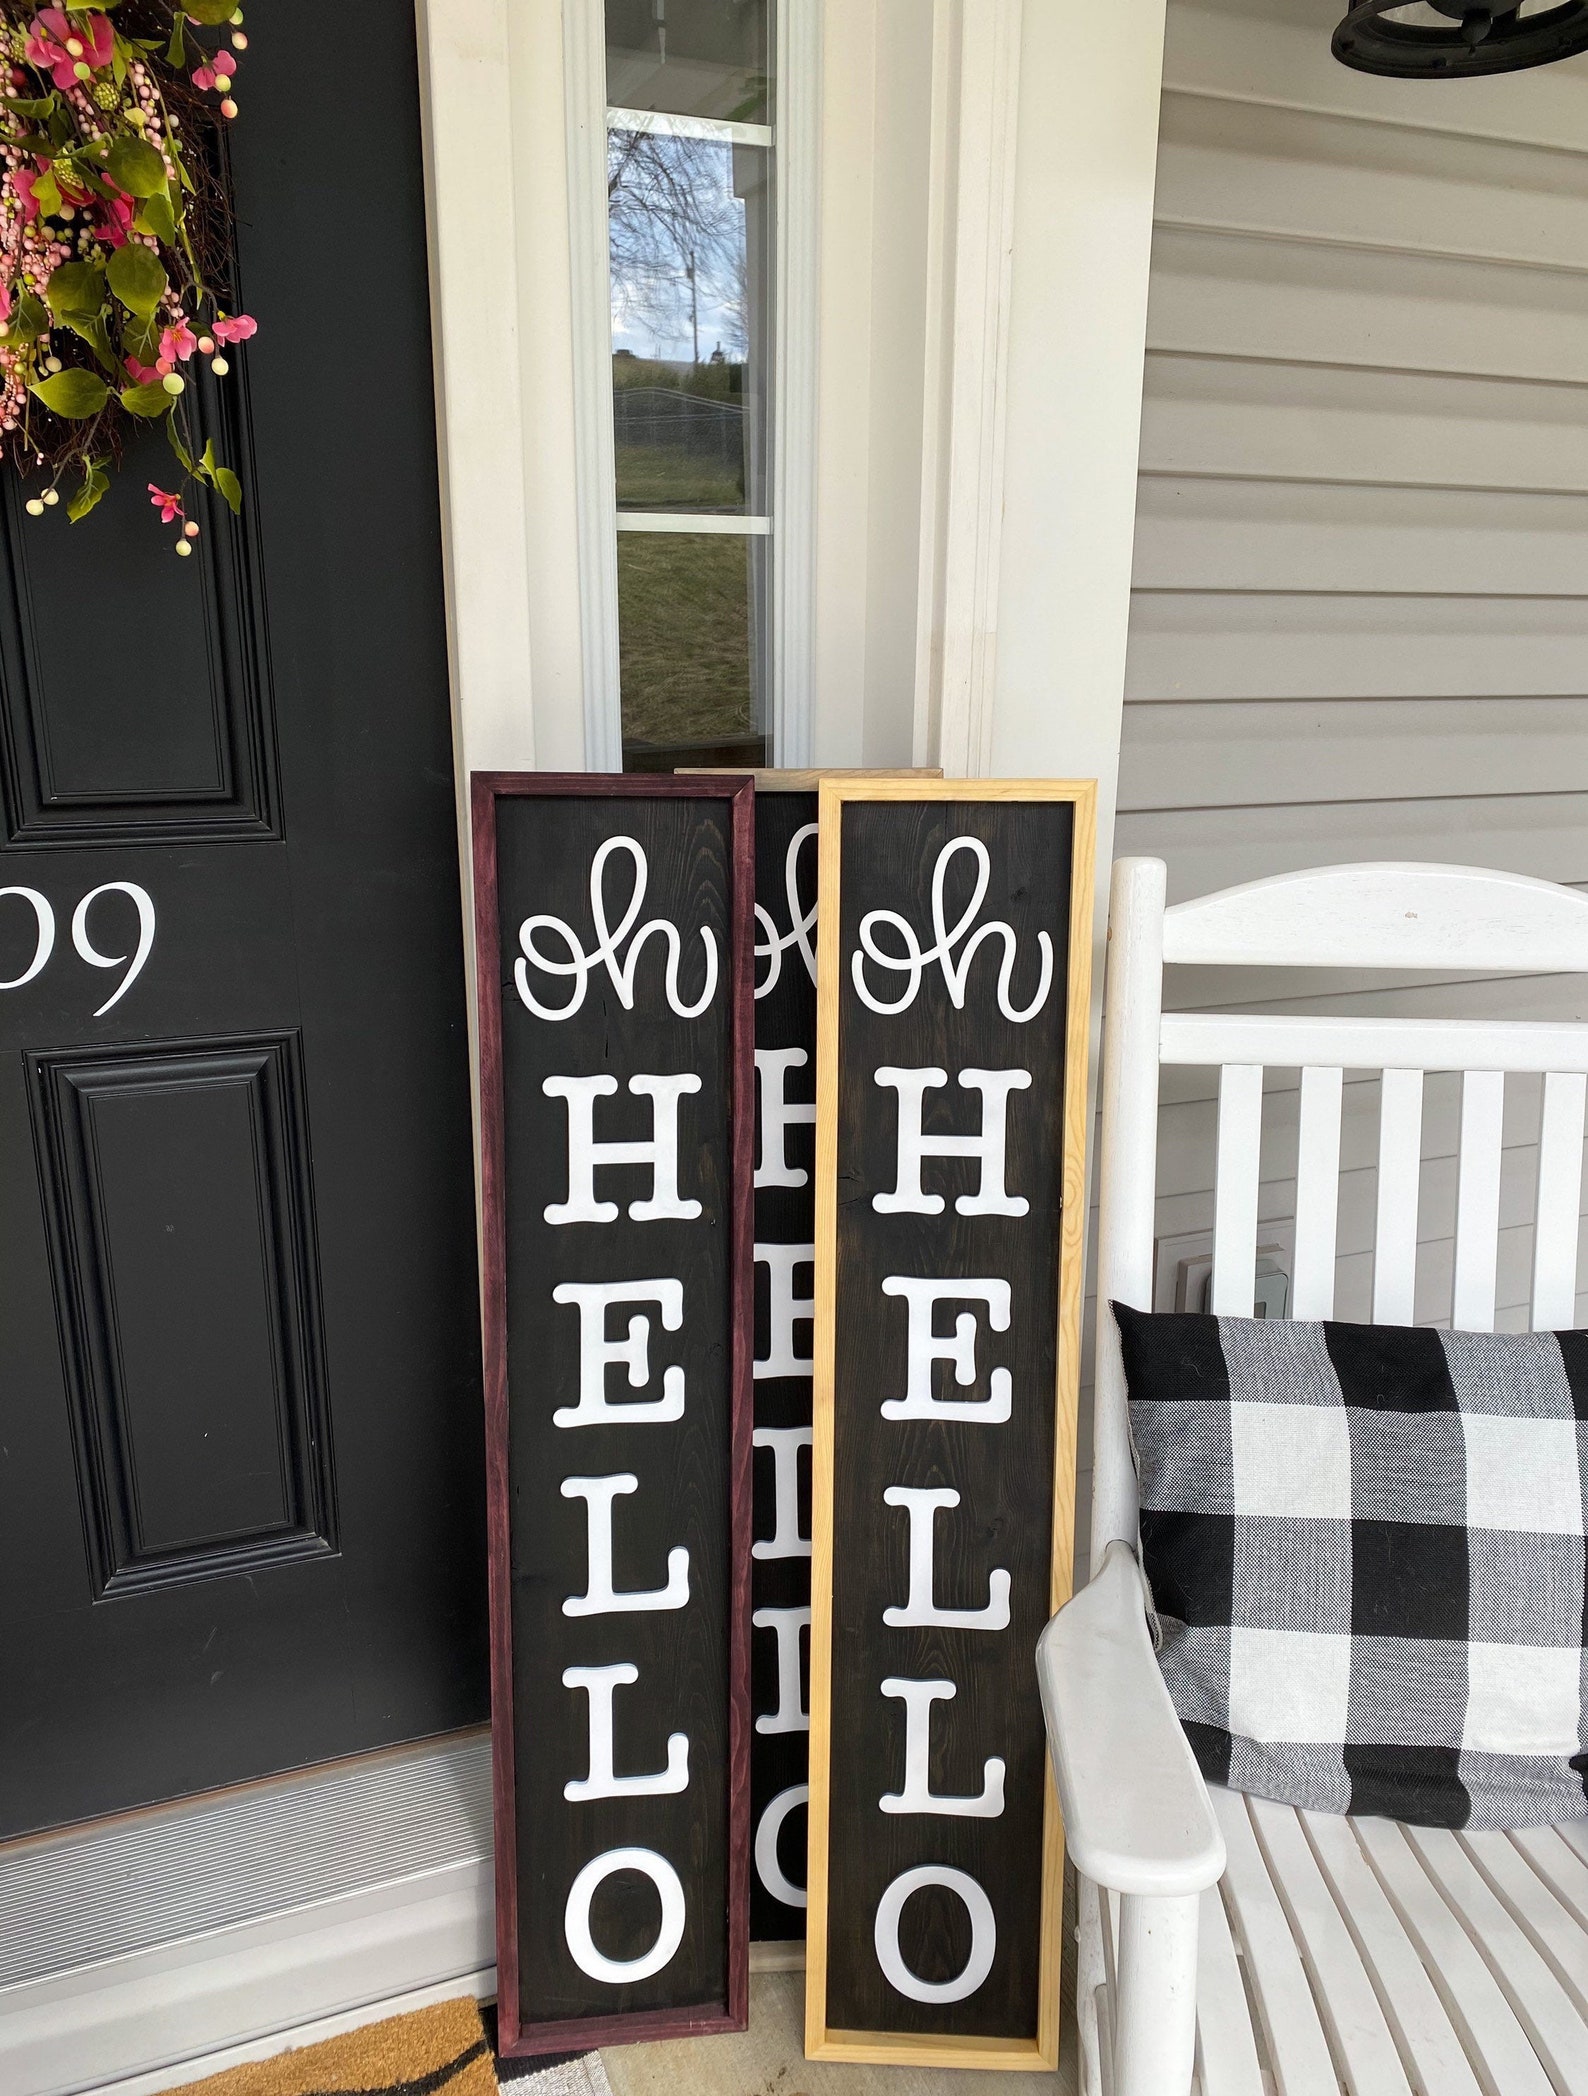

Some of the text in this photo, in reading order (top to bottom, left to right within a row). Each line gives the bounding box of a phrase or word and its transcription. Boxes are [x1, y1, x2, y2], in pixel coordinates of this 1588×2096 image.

[513, 835, 719, 1022] oh
[851, 835, 1054, 1024] oh
[542, 1073, 703, 1984] HELLO
[871, 1066, 1033, 2004] HELLO
